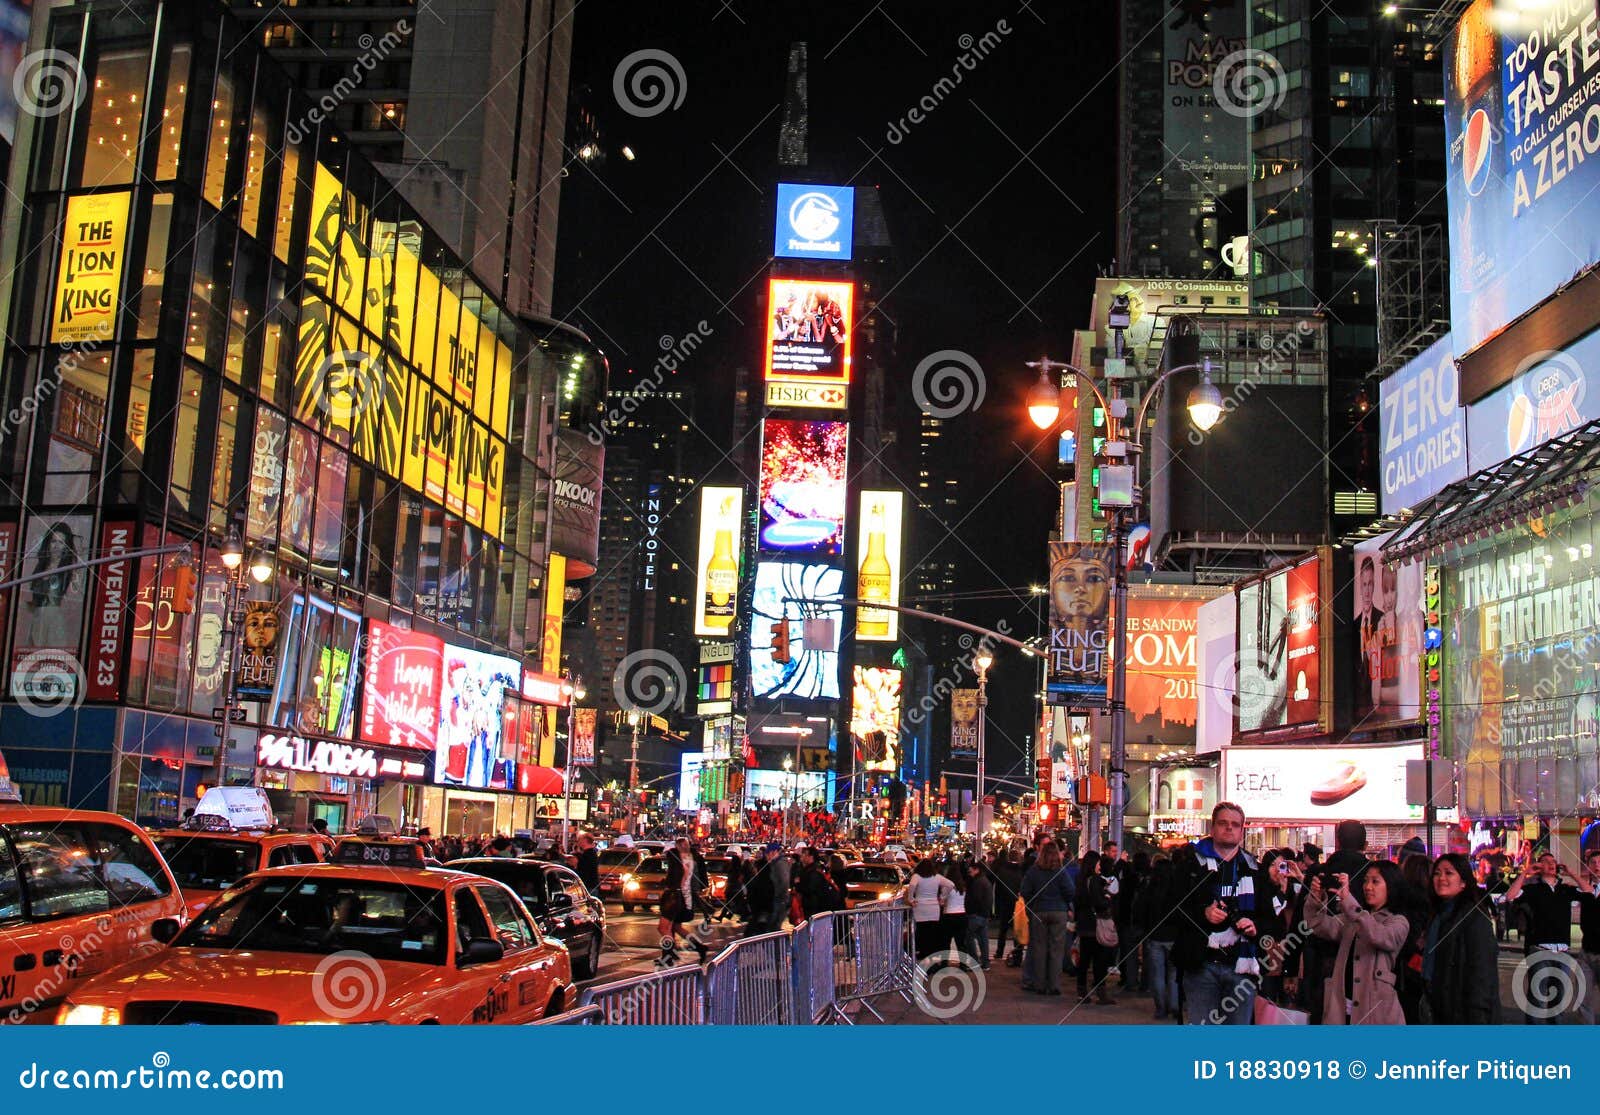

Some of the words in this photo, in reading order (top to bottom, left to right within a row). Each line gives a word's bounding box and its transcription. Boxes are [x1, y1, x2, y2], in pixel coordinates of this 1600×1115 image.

[1505, 31, 1540, 83] TOO
[1507, 8, 1600, 136] TASTE
[1172, 96, 1193, 108] ON
[1510, 145, 1523, 165] TO
[1524, 124, 1547, 154] CALL
[1548, 72, 1600, 132] OURSELVES
[1513, 168, 1531, 218] A
[1533, 104, 1600, 200] ZERO
[78, 221, 113, 241] THE
[66, 250, 116, 283] LION
[1147, 281, 1172, 291] 100%
[1175, 282, 1232, 292] Colombian
[60, 288, 112, 323] KING
[449, 334, 475, 389] THE
[769, 386, 817, 402] HSBC
[1538, 367, 1561, 396] pepsi
[1384, 351, 1458, 455] ZERO
[1536, 376, 1585, 443] MAX
[411, 363, 458, 461] LION
[456, 400, 499, 490] KING
[1385, 421, 1461, 495] CALORIES
[644, 499, 660, 590] NOVOTEL
[99, 529, 128, 655] NOVEMBER
[1428, 568, 1439, 625] TOYS
[701, 644, 735, 658] INGLOT
[1051, 628, 1106, 649] KING
[97, 659, 116, 686] 23
[242, 655, 275, 667] KING
[242, 667, 275, 681] TUT
[393, 653, 434, 697] Happy
[1051, 648, 1104, 672] TUT
[1428, 653, 1439, 683] US
[952, 727, 976, 737] KING
[952, 736, 976, 747] TUT
[1235, 773, 1282, 792] REAL
[861, 802, 874, 819] R
